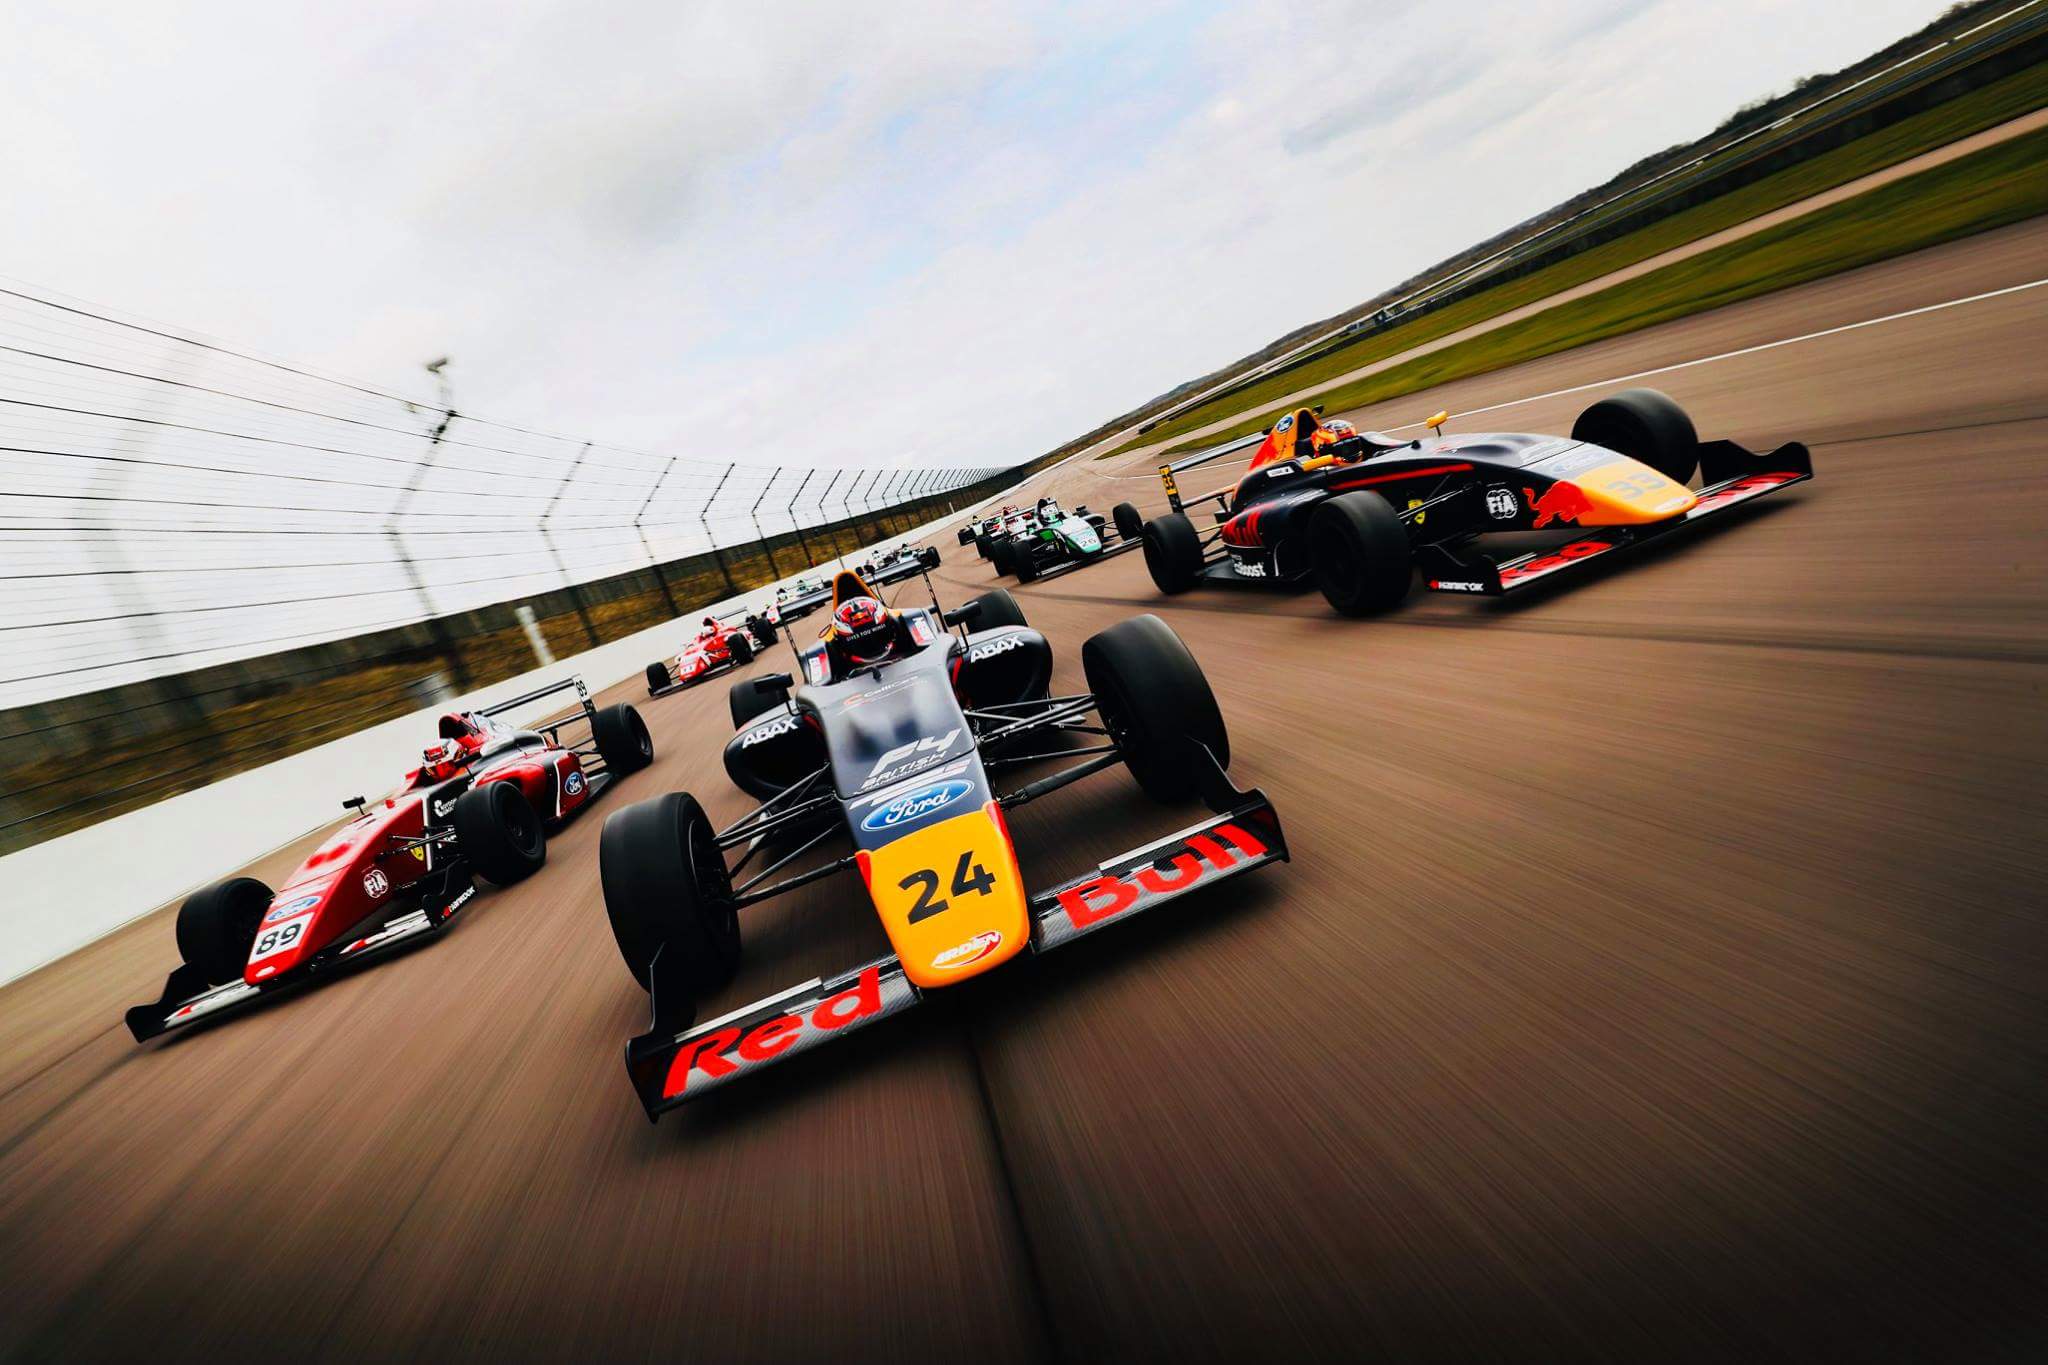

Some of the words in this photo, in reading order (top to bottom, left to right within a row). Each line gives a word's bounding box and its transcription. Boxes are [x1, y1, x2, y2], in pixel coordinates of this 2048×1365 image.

[1605, 472, 1666, 499] 33
[970, 635, 1025, 664] ABAX
[742, 716, 799, 750] ABAX
[860, 751, 947, 789] BRITISH
[867, 728, 962, 779] F4
[884, 787, 950, 824] Ford
[897, 850, 997, 925] 24
[1056, 824, 1269, 929] Bull
[256, 923, 302, 956] 89
[662, 966, 883, 1099] Red
